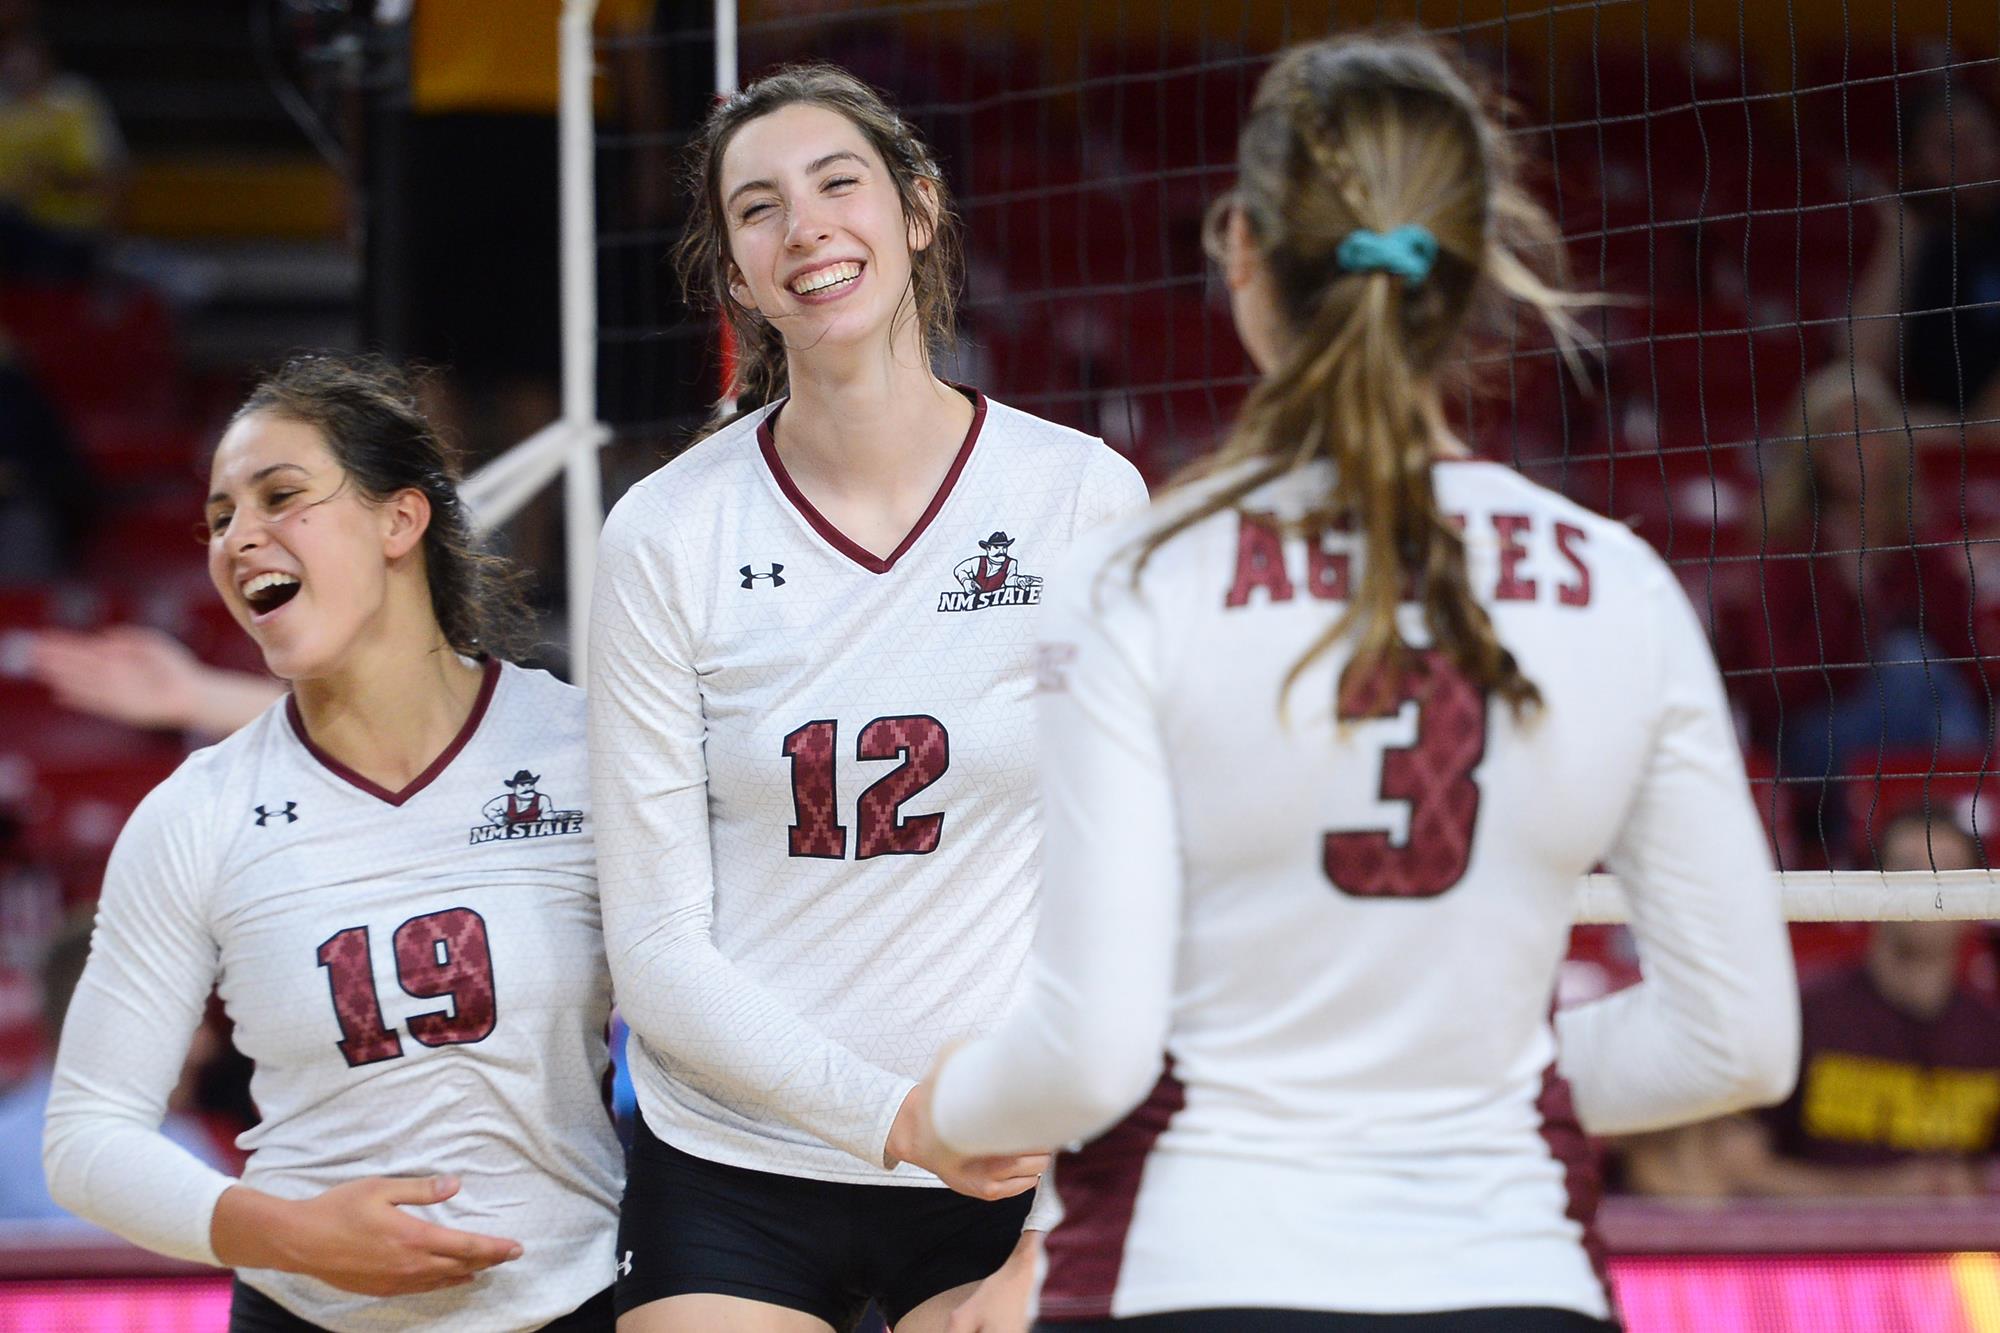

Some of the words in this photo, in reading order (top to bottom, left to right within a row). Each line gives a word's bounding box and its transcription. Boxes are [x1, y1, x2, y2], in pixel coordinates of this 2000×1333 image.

[938, 592, 977, 612] NM
[977, 585, 1043, 608] STATE
[1226, 511, 1591, 607] AGES
[469, 824, 508, 845] NM
[509, 816, 584, 839] STATE
[782, 714, 950, 860] 12
[1323, 643, 1487, 897] 3
[316, 906, 497, 1068] 19
